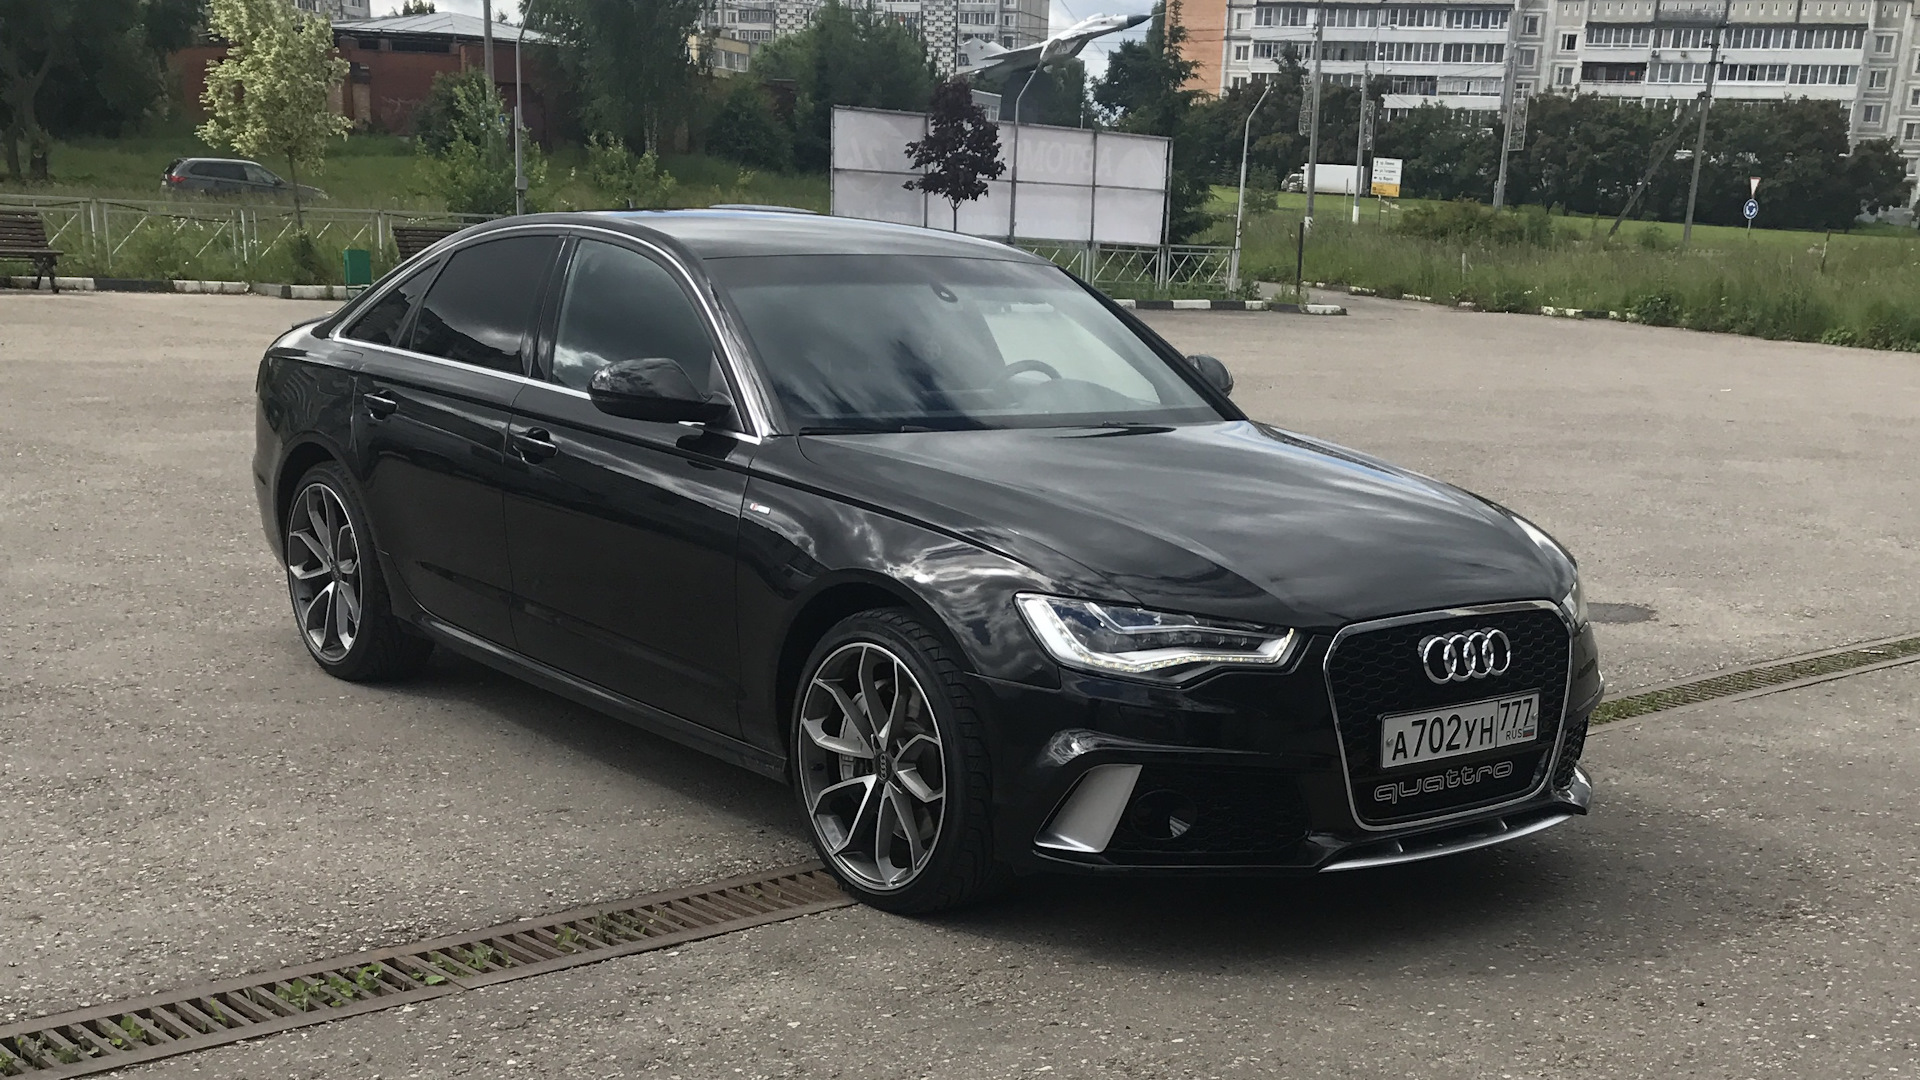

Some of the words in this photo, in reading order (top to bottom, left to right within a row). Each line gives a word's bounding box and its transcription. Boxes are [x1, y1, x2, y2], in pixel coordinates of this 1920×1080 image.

[1500, 698, 1533, 731] 777
[1505, 729, 1523, 741] RUS
[1374, 761, 1513, 804] quattro
